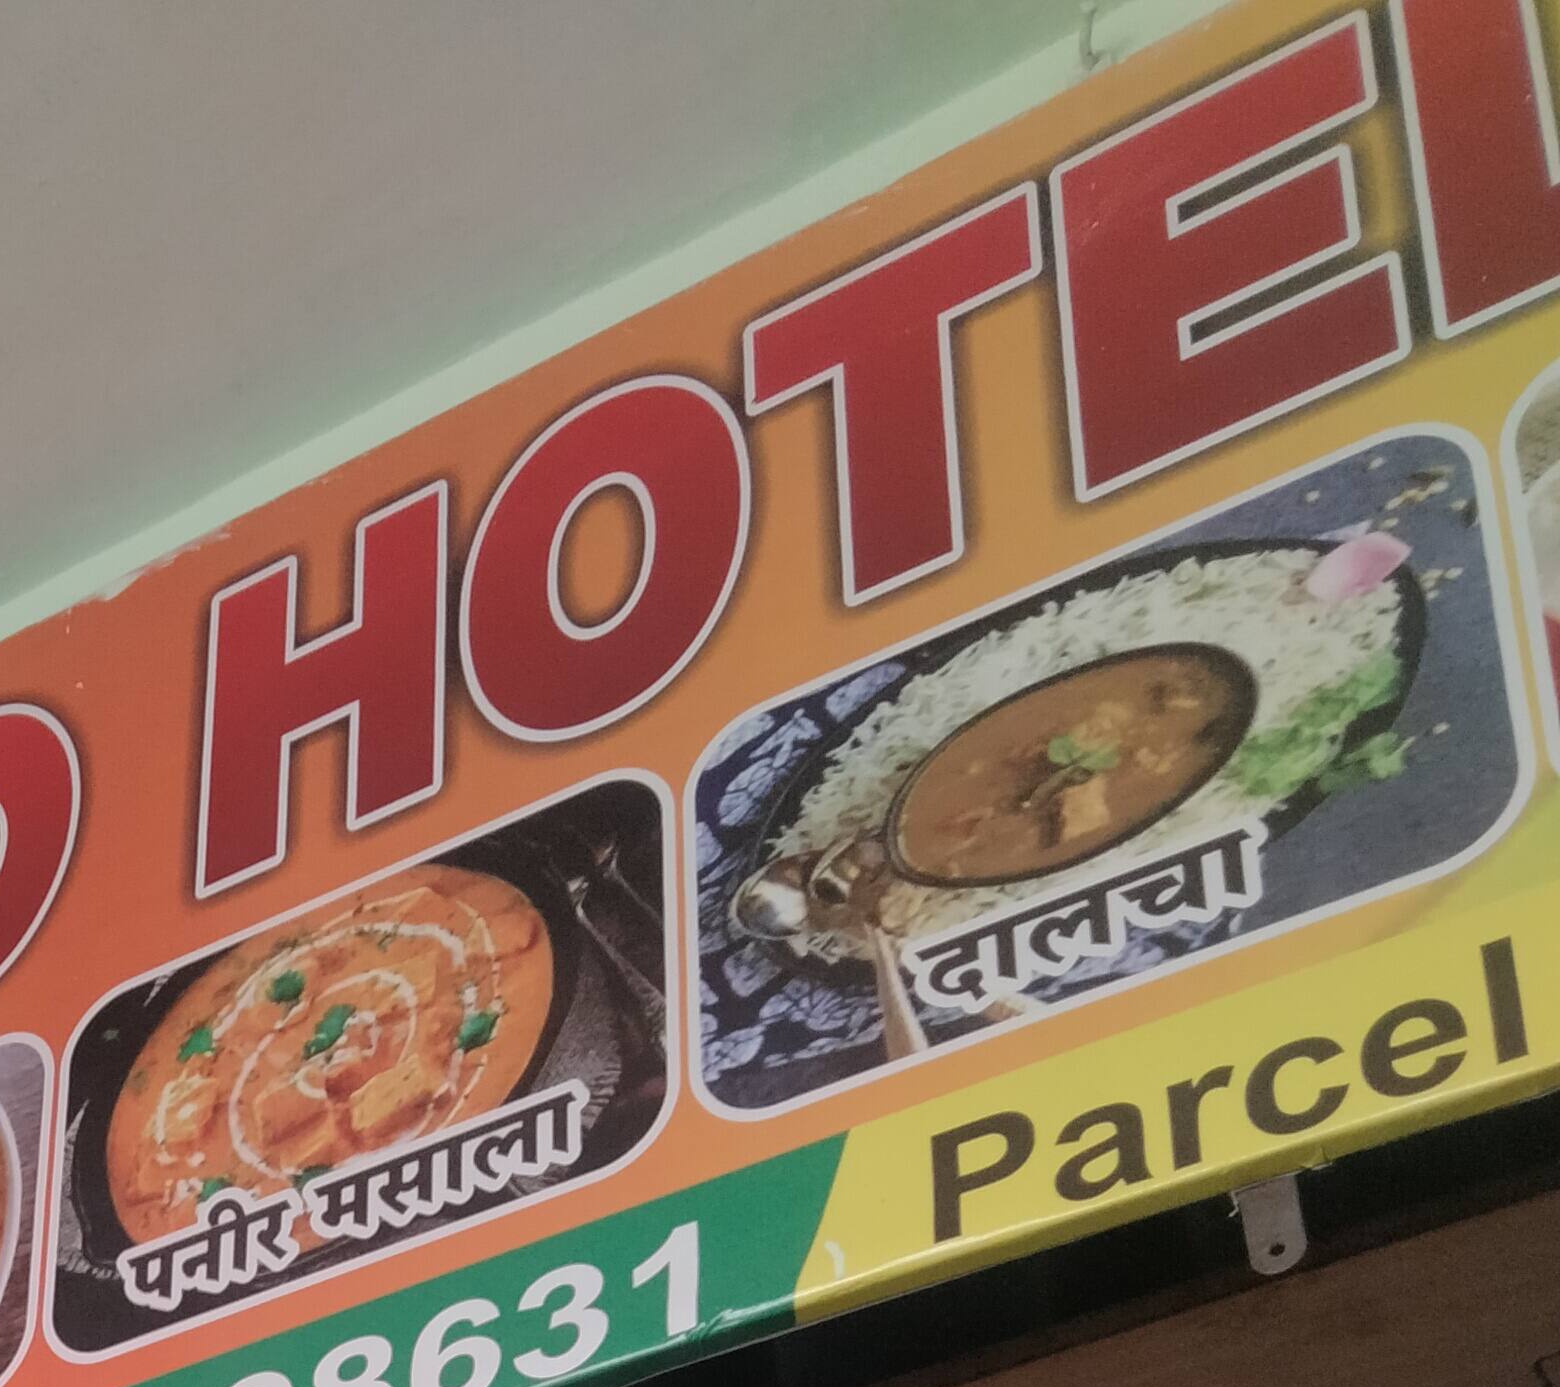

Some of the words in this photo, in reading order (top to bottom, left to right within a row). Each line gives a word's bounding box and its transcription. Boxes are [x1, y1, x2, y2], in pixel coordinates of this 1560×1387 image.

[914, 828, 1262, 1003] दालचा
[928, 936, 1530, 1245] Parcel
[126, 1188, 291, 1299] पनीर
[314, 1092, 581, 1234] मसाला
